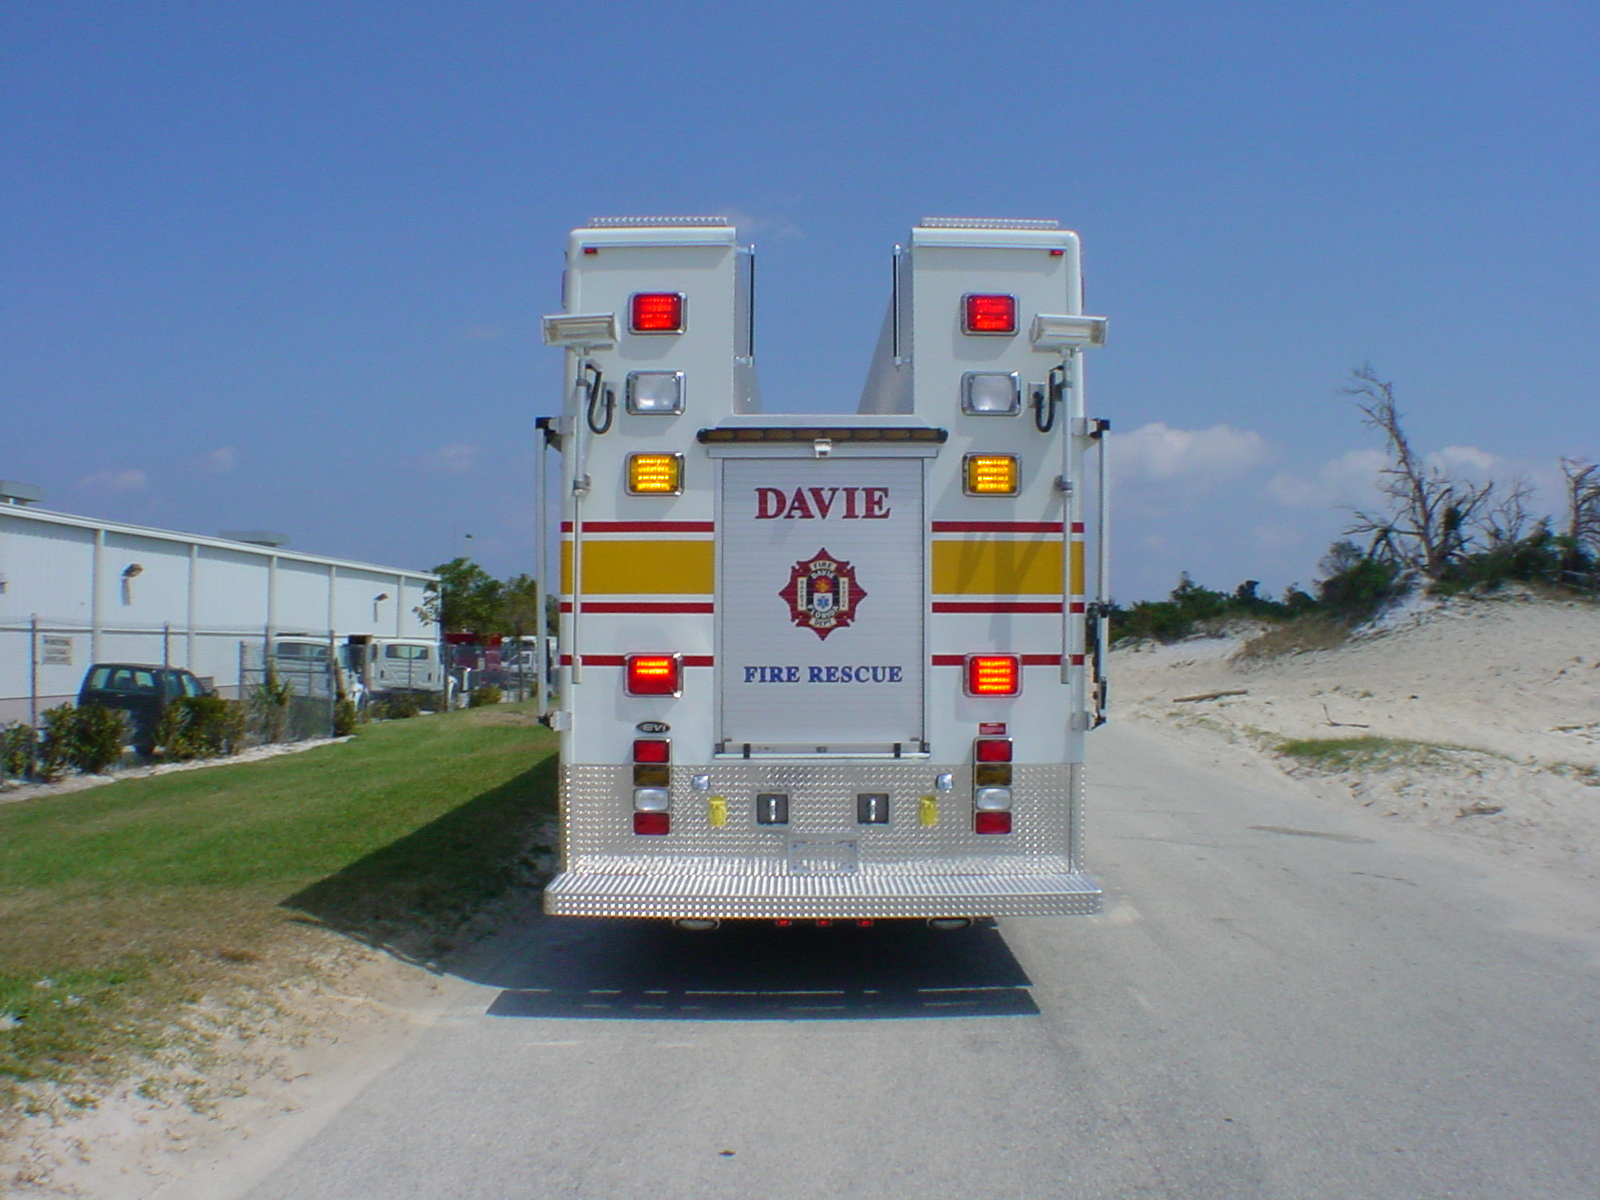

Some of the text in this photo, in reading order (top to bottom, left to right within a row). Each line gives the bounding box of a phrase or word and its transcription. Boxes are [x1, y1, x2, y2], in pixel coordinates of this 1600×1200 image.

[754, 487, 891, 519] DAVIE
[744, 666, 903, 683] FIRE RESCUE
